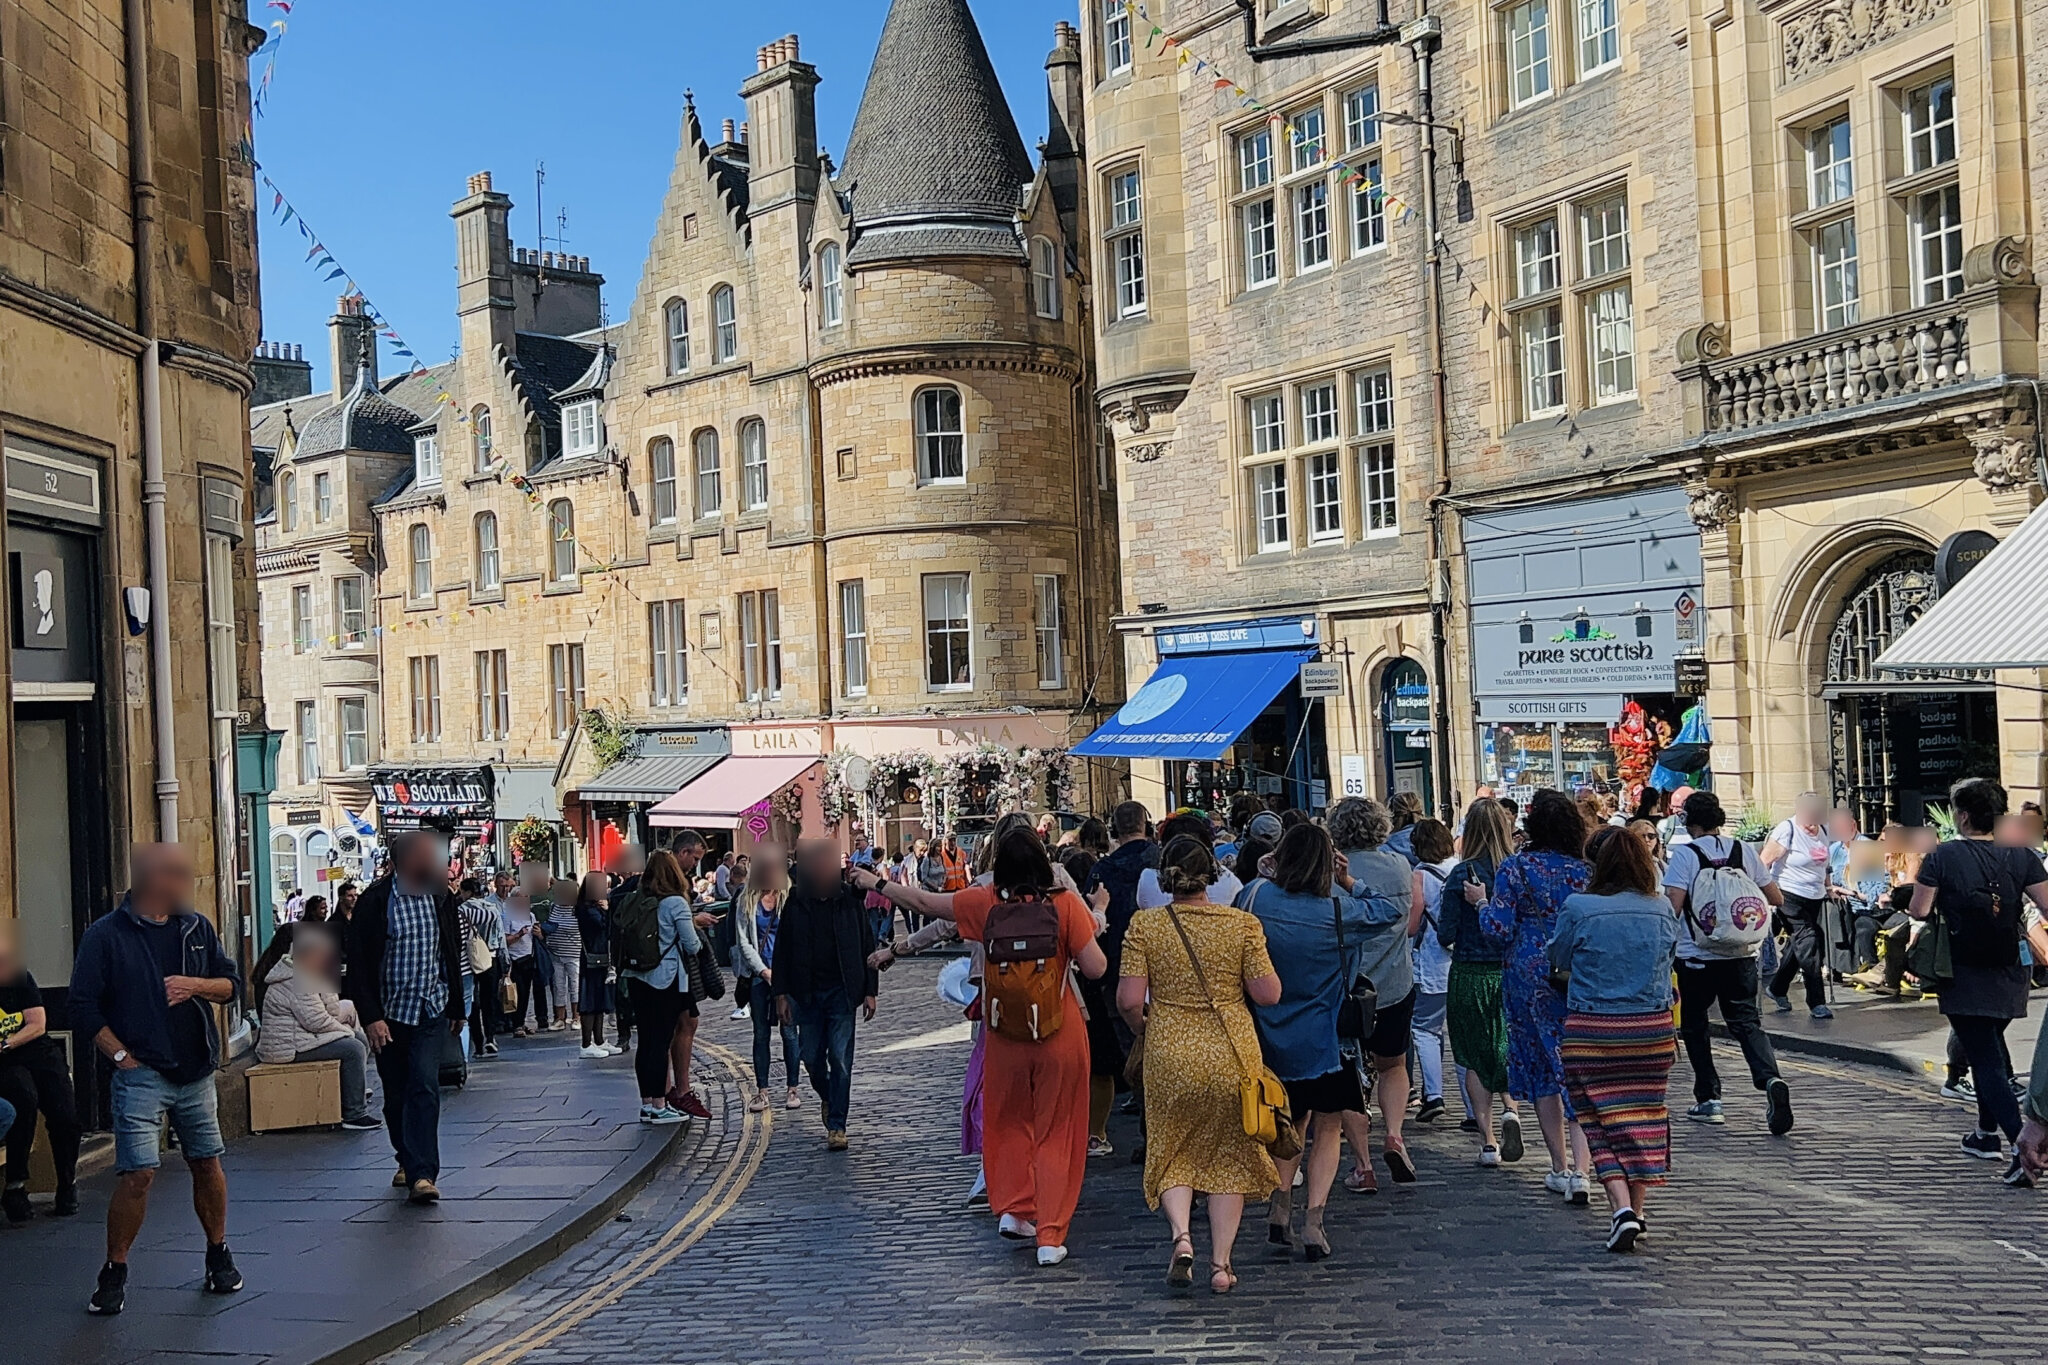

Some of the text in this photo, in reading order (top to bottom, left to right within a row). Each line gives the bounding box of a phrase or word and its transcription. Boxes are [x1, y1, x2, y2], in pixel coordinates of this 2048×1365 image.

[44, 472, 58, 493] 52
[1956, 549, 1991, 562] SCRA
[1179, 632, 1209, 644] SOUTHERN
[1210, 629, 1229, 642] CROSS
[1518, 641, 1654, 669] pure scottish
[1304, 668, 1338, 677] Edinburgh
[1573, 667, 1589, 675] ROCK
[1654, 672, 1675, 680] BATTE
[1396, 697, 1430, 708] backpack
[1508, 702, 1587, 713] SCOTTISH GIFTS
[1919, 711, 1957, 724] badges
[753, 732, 798, 749] LAILA
[1156, 733, 1199, 743] CROSS
[1346, 778, 1363, 794] 65
[373, 784, 487, 802] WE SCOTLAND
